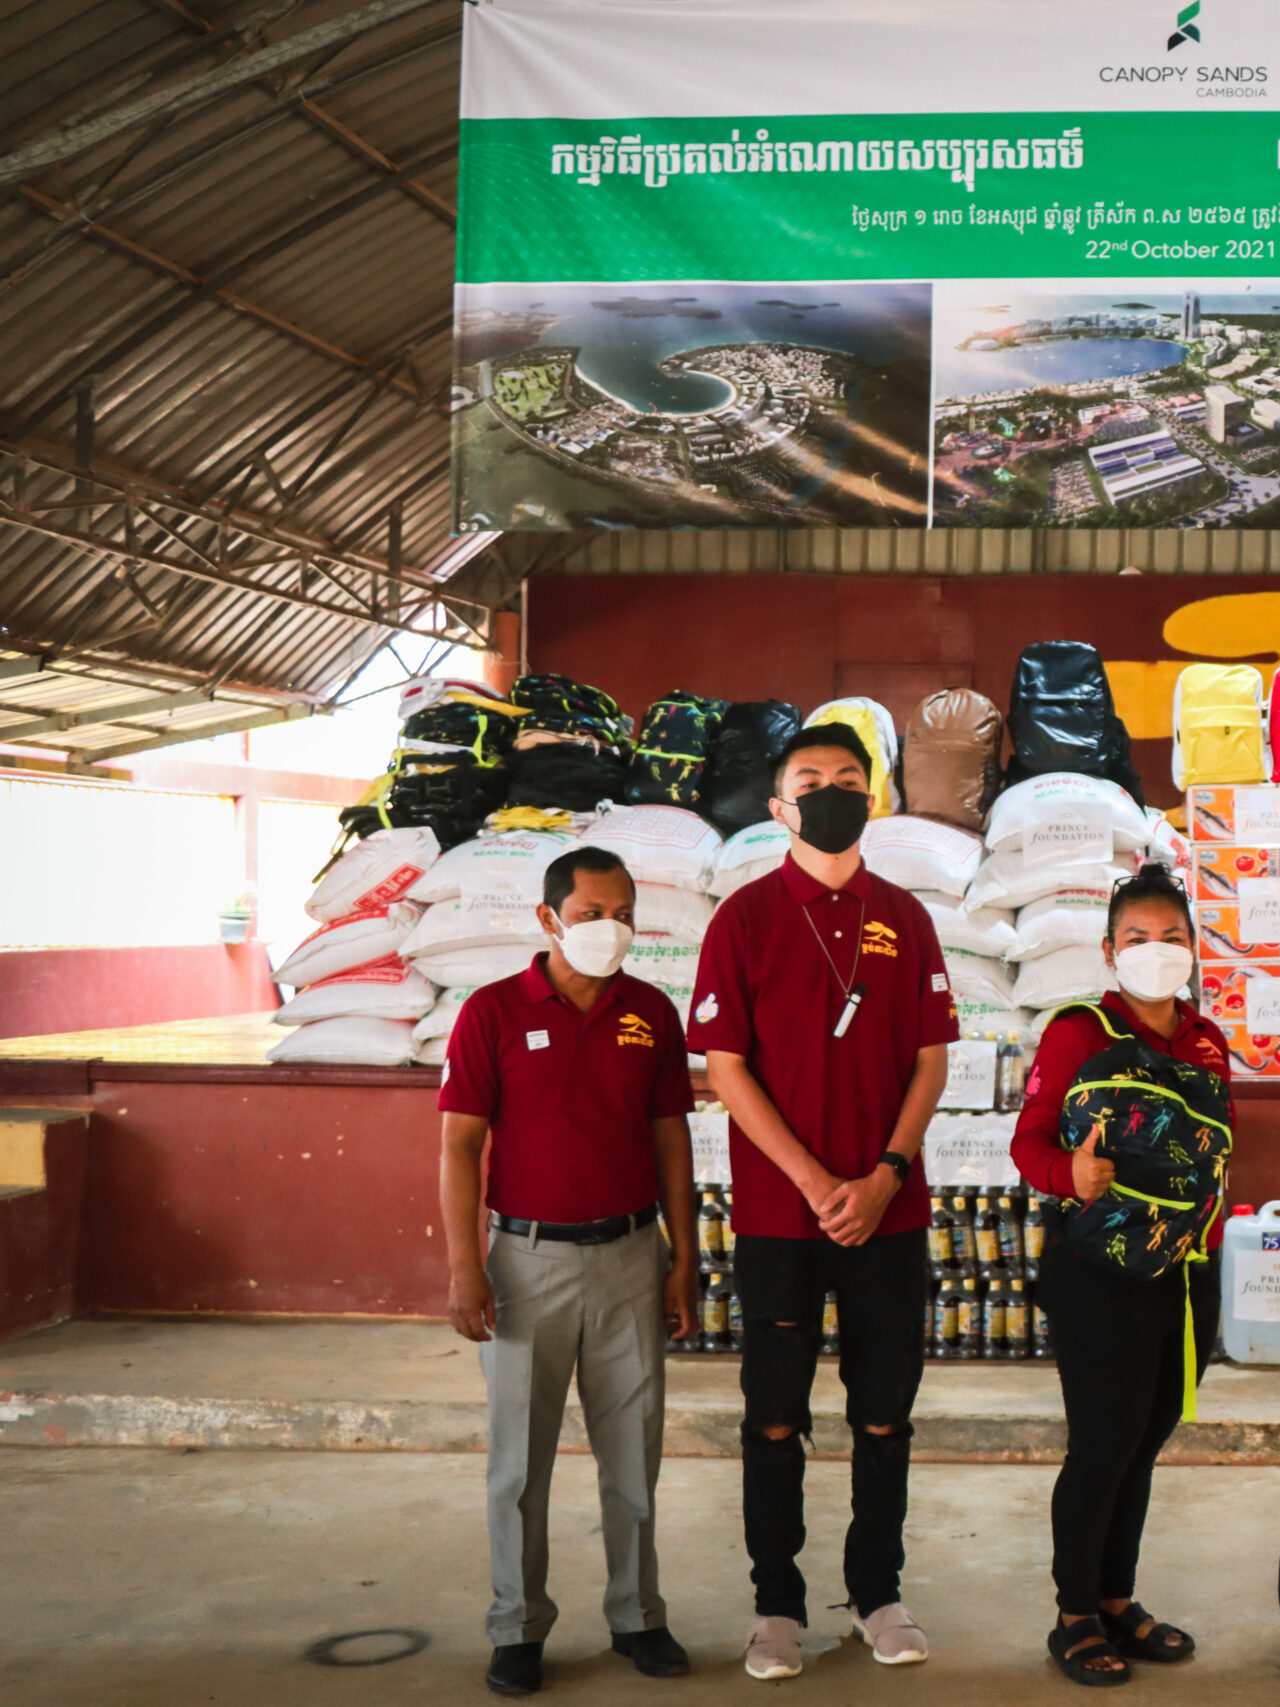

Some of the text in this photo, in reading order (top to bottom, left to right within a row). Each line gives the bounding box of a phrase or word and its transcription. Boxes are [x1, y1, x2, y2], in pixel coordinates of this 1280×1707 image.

[1099, 66, 1268, 82] CANOPY SANDS
[1196, 88, 1268, 98] CAMBODIA
[1131, 240, 1220, 259] October
[1225, 240, 1276, 259] 2021
[1048, 824, 1090, 832] PRINCE
[952, 1140, 995, 1148] PRINCE
